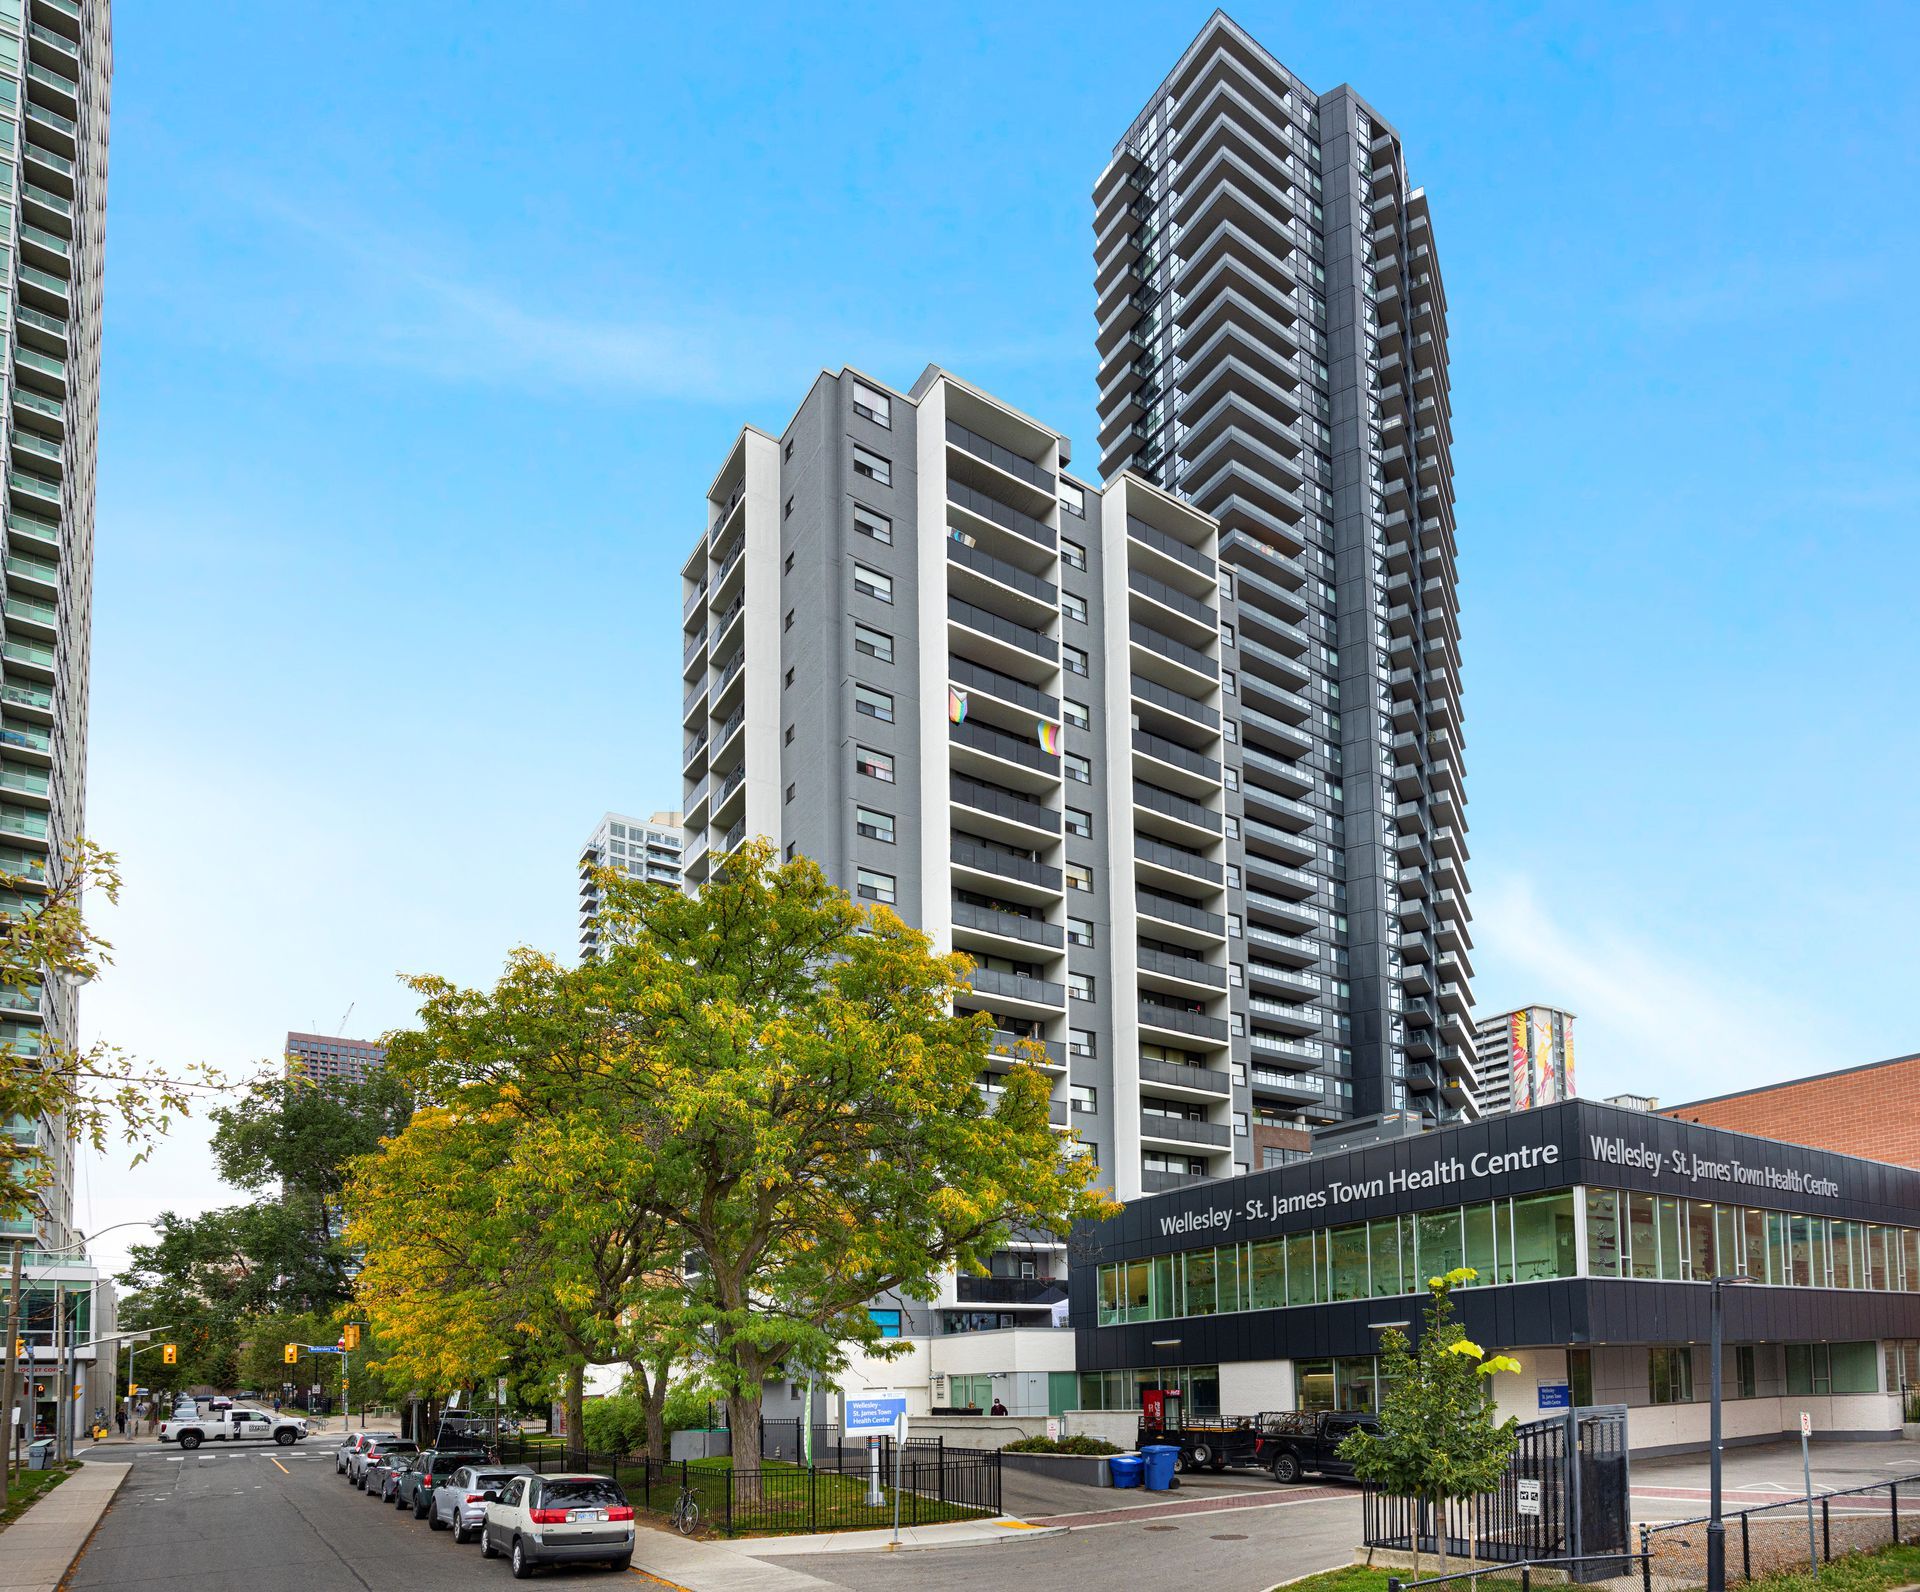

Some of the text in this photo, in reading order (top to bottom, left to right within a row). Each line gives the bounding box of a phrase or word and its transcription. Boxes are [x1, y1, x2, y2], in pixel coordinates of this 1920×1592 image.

[1160, 1207, 1232, 1236] Wellesley
[1246, 1199, 1268, 1221] St.
[1270, 1190, 1327, 1222] James
[1328, 1179, 1383, 1205] Town
[1389, 1157, 1465, 1194] Health
[1471, 1144, 1559, 1177] Centre
[1590, 1135, 1661, 1177] Wellesley
[1672, 1150, 1690, 1175] St.
[1691, 1154, 1731, 1182] James
[1731, 1161, 1765, 1187] Town
[1765, 1166, 1803, 1193] Health
[1803, 1174, 1839, 1198] Centre
